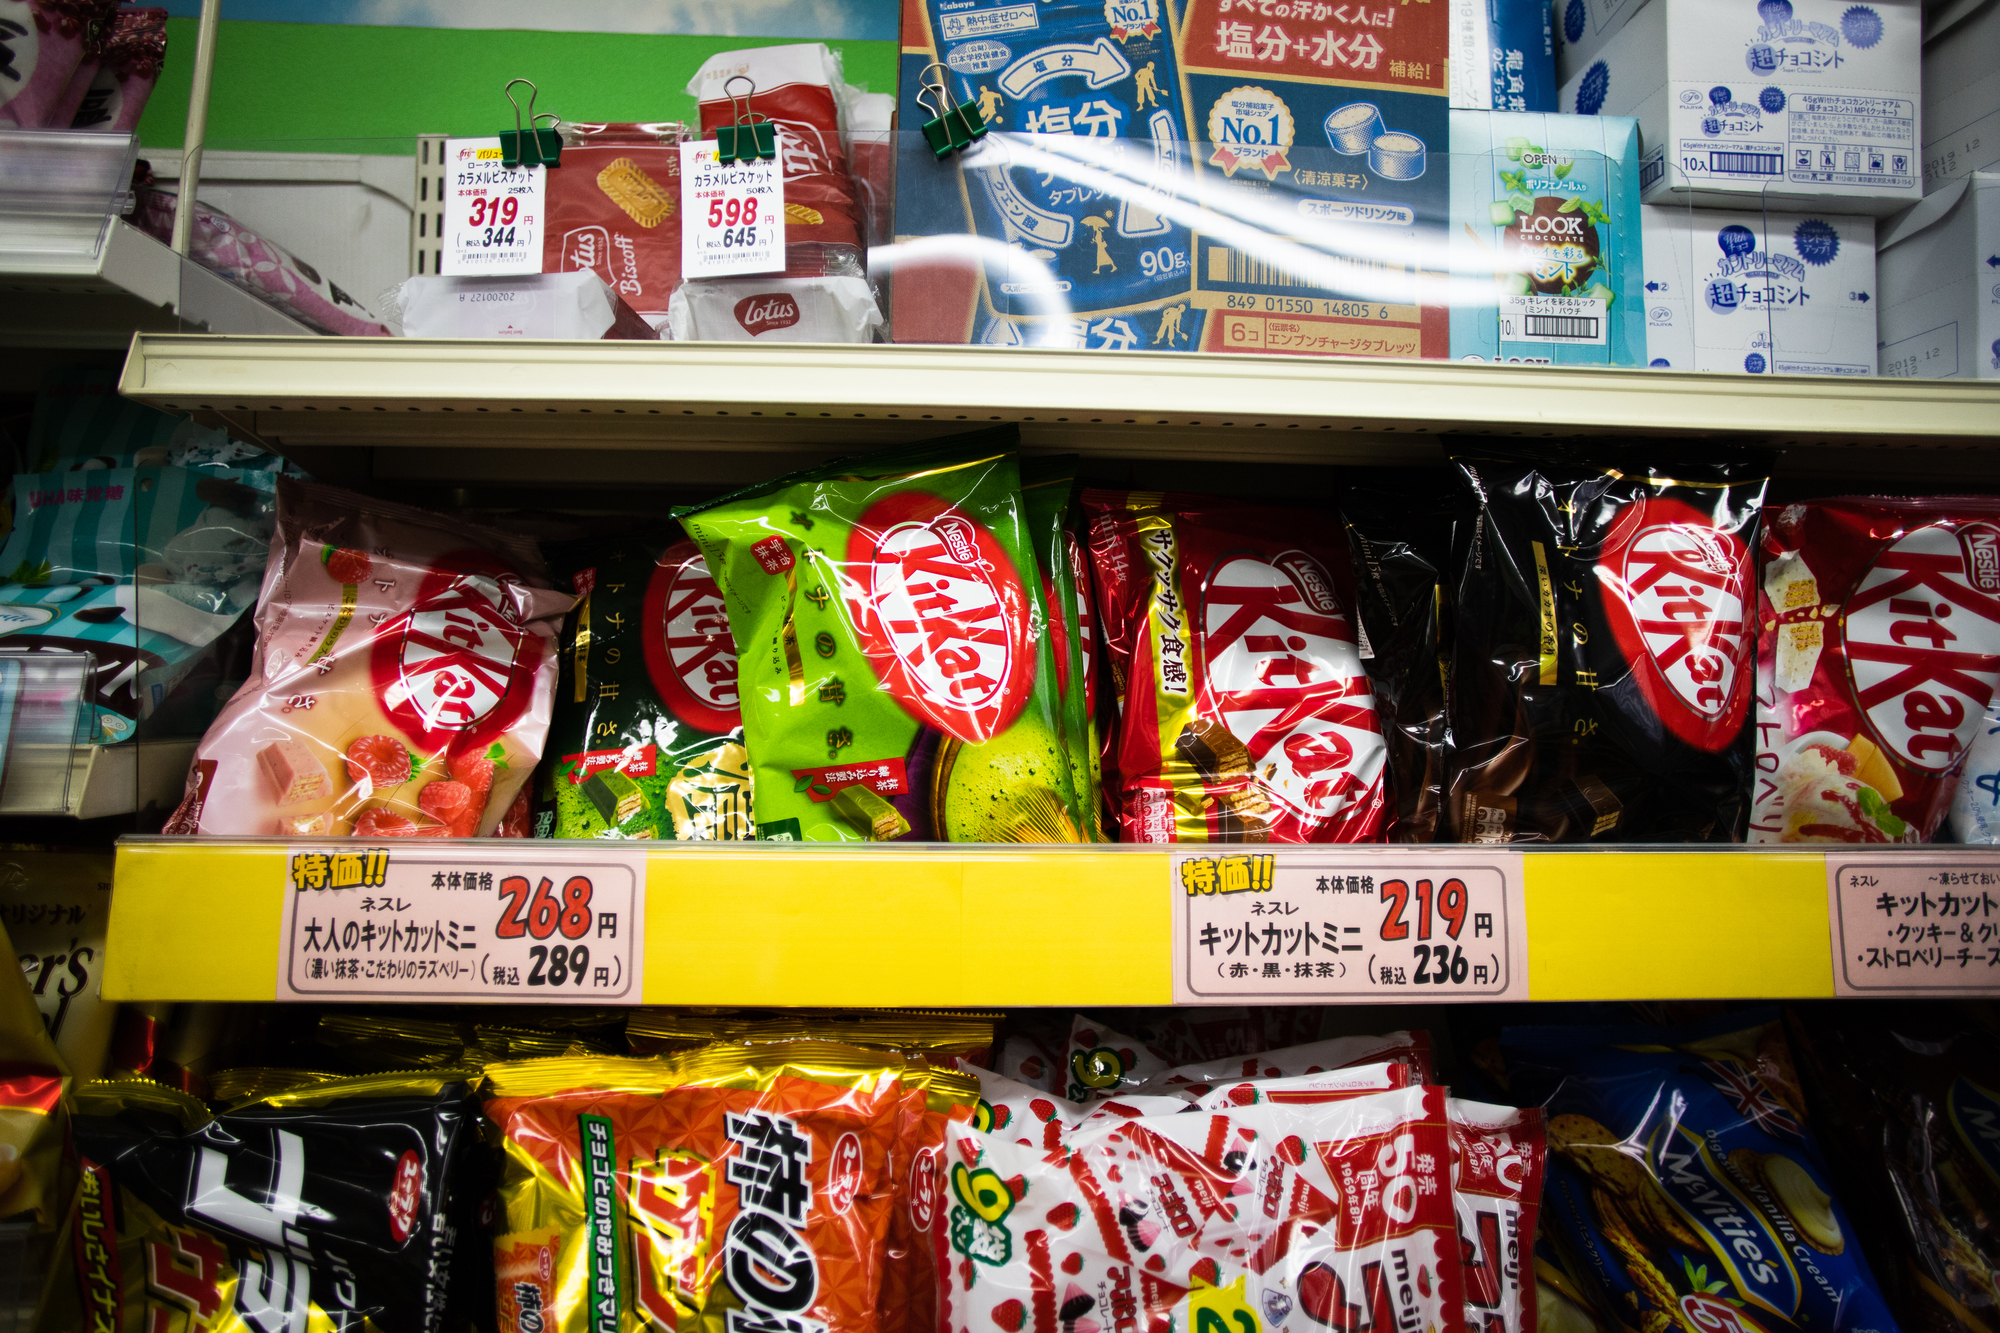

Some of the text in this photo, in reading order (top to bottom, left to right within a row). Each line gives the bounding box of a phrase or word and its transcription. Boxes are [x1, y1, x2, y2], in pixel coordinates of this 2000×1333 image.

[1112, 1, 1153, 23] No.1
[950, 50, 1008, 64] 日本学校保健会
[1216, 21, 1384, 70] 塩分+水分
[1389, 59, 1431, 80] 補給!
[1750, 46, 1845, 71] 超チョコミント
[1221, 113, 1281, 146] No.1
[1703, 119, 1764, 134] 超チョコミント
[1233, 146, 1269, 158] ブランド
[1523, 153, 1558, 165] OPEN
[467, 161, 500, 169] ロータス
[457, 170, 534, 186] カラメルビスケット
[694, 170, 773, 187] カラメルビスケット
[1525, 178, 1587, 192] ポリフェノール入り
[457, 186, 534, 197] 本体価格 25枚入
[694, 186, 774, 199] 本体価格 50枚入
[1307, 202, 1407, 222] スポーツドリンク味
[482, 227, 516, 248] 344
[723, 226, 757, 248] 645
[1519, 215, 1584, 236] LOOK
[1520, 235, 1585, 243] CHOCOLATE
[614, 231, 642, 297] Biscoff
[1533, 262, 1574, 280] ミント
[1717, 252, 1806, 282] カントリーマアム
[1227, 295, 1389, 320] 849 01550 14805 6
[1710, 282, 1811, 309] 超チョコミント
[744, 299, 794, 326] Lotus
[1268, 333, 1416, 354] エンブンチャージタブレッツ
[29, 484, 126, 509] UHA味覚糖
[1149, 528, 1188, 696] サクッサク食感!
[877, 544, 1009, 706] KitKat
[1631, 550, 1743, 712] KitKat
[1848, 550, 2000, 763] KitKat
[1206, 582, 1386, 812] KitKat
[431, 871, 494, 891] 本体価格
[1316, 875, 1375, 895] 本体価格
[1850, 875, 1879, 887] ネスレ
[359, 897, 412, 914] ネスレ
[1250, 901, 1300, 916] ネスレ
[1876, 891, 1999, 918] キットカット
[303, 917, 477, 954] 大人のキットカットミニ
[1199, 921, 1364, 957] キットカットミニ
[526, 945, 590, 987] 289
[1413, 944, 1468, 985] 236
[839, 1136, 857, 1213] ユーラク
[1415, 1153, 1438, 1197] 発売
[1299, 1183, 1310, 1214] meiji
[1341, 1161, 1363, 1226] 1969年8月
[1359, 1168, 1380, 1211] 周年
[1151, 1173, 1197, 1238] アポロ
[1749, 1183, 1796, 1243] Vanilla
[1793, 1244, 1842, 1305] Cream
[1149, 1281, 1163, 1314] meiji
